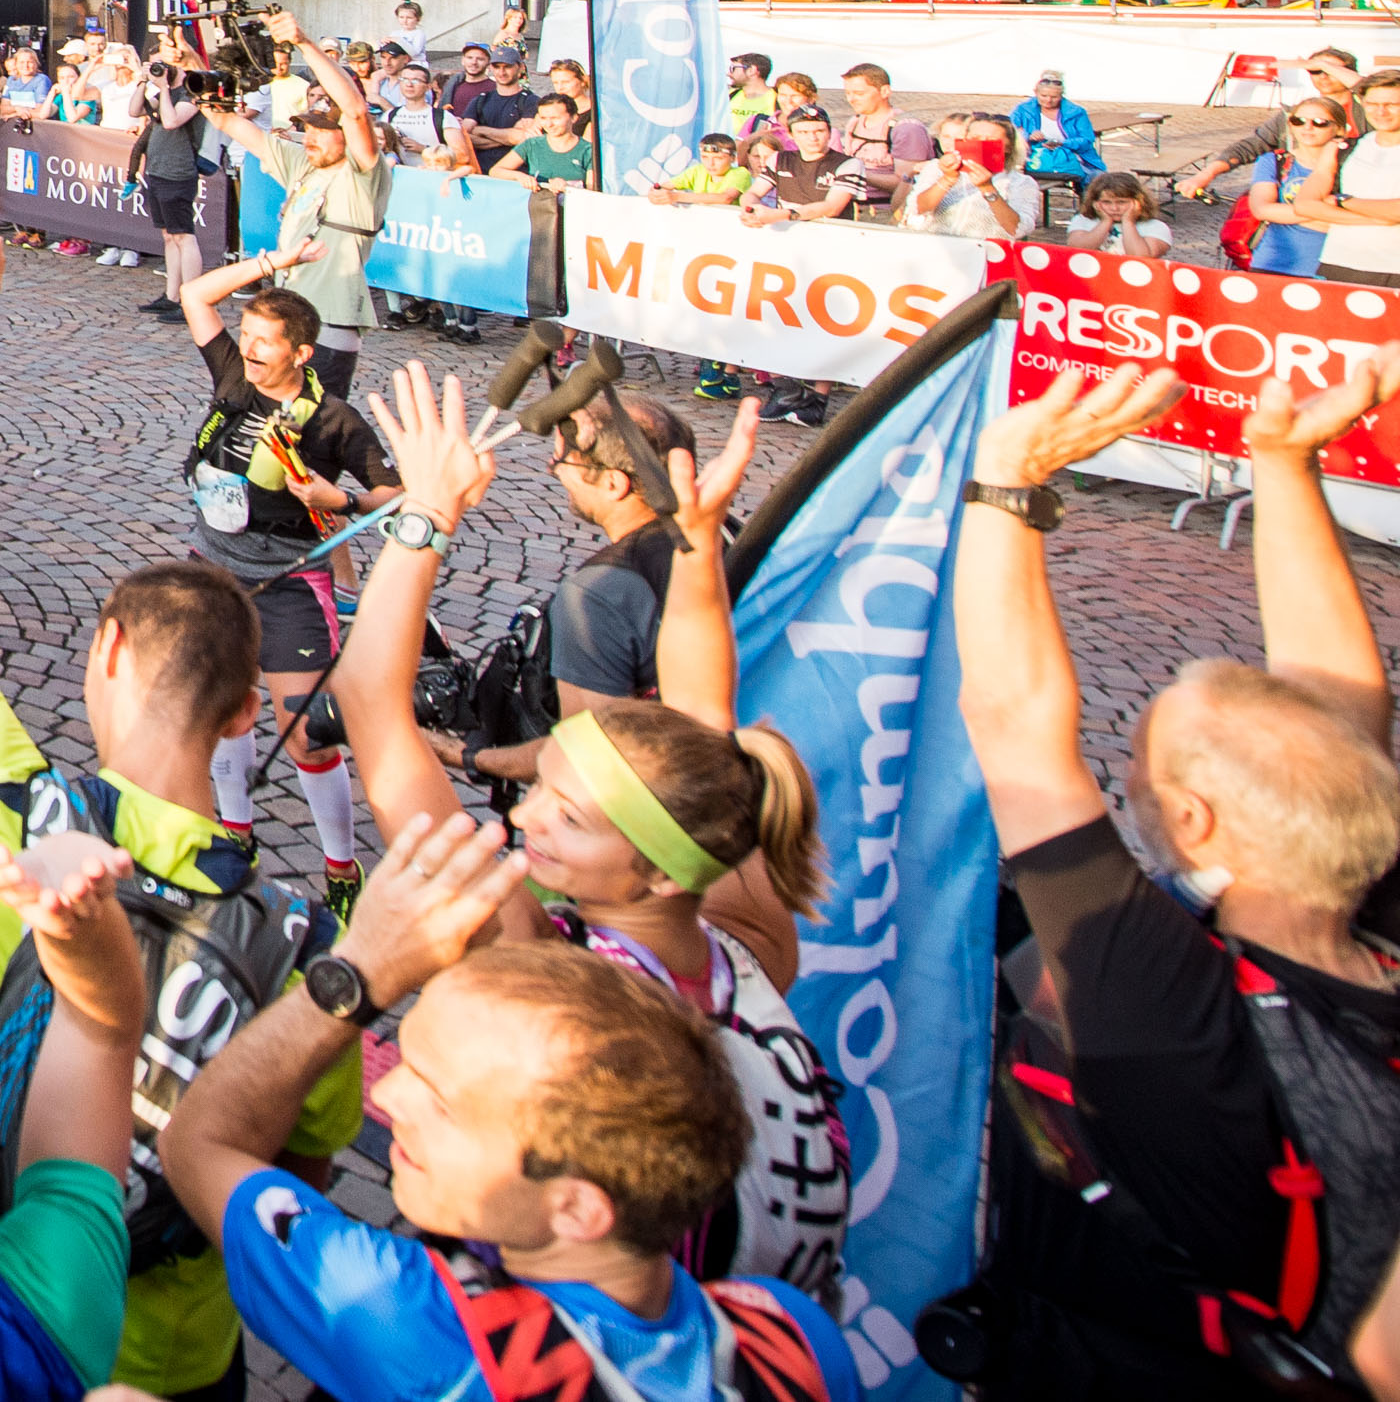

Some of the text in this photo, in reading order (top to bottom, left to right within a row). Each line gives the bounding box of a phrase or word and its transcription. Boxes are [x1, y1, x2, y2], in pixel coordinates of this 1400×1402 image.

[46, 178, 207, 228] MONTRX
[378, 215, 488, 260] umbia
[585, 234, 949, 349] MIGROS
[1018, 291, 1381, 389] RESSPORT
